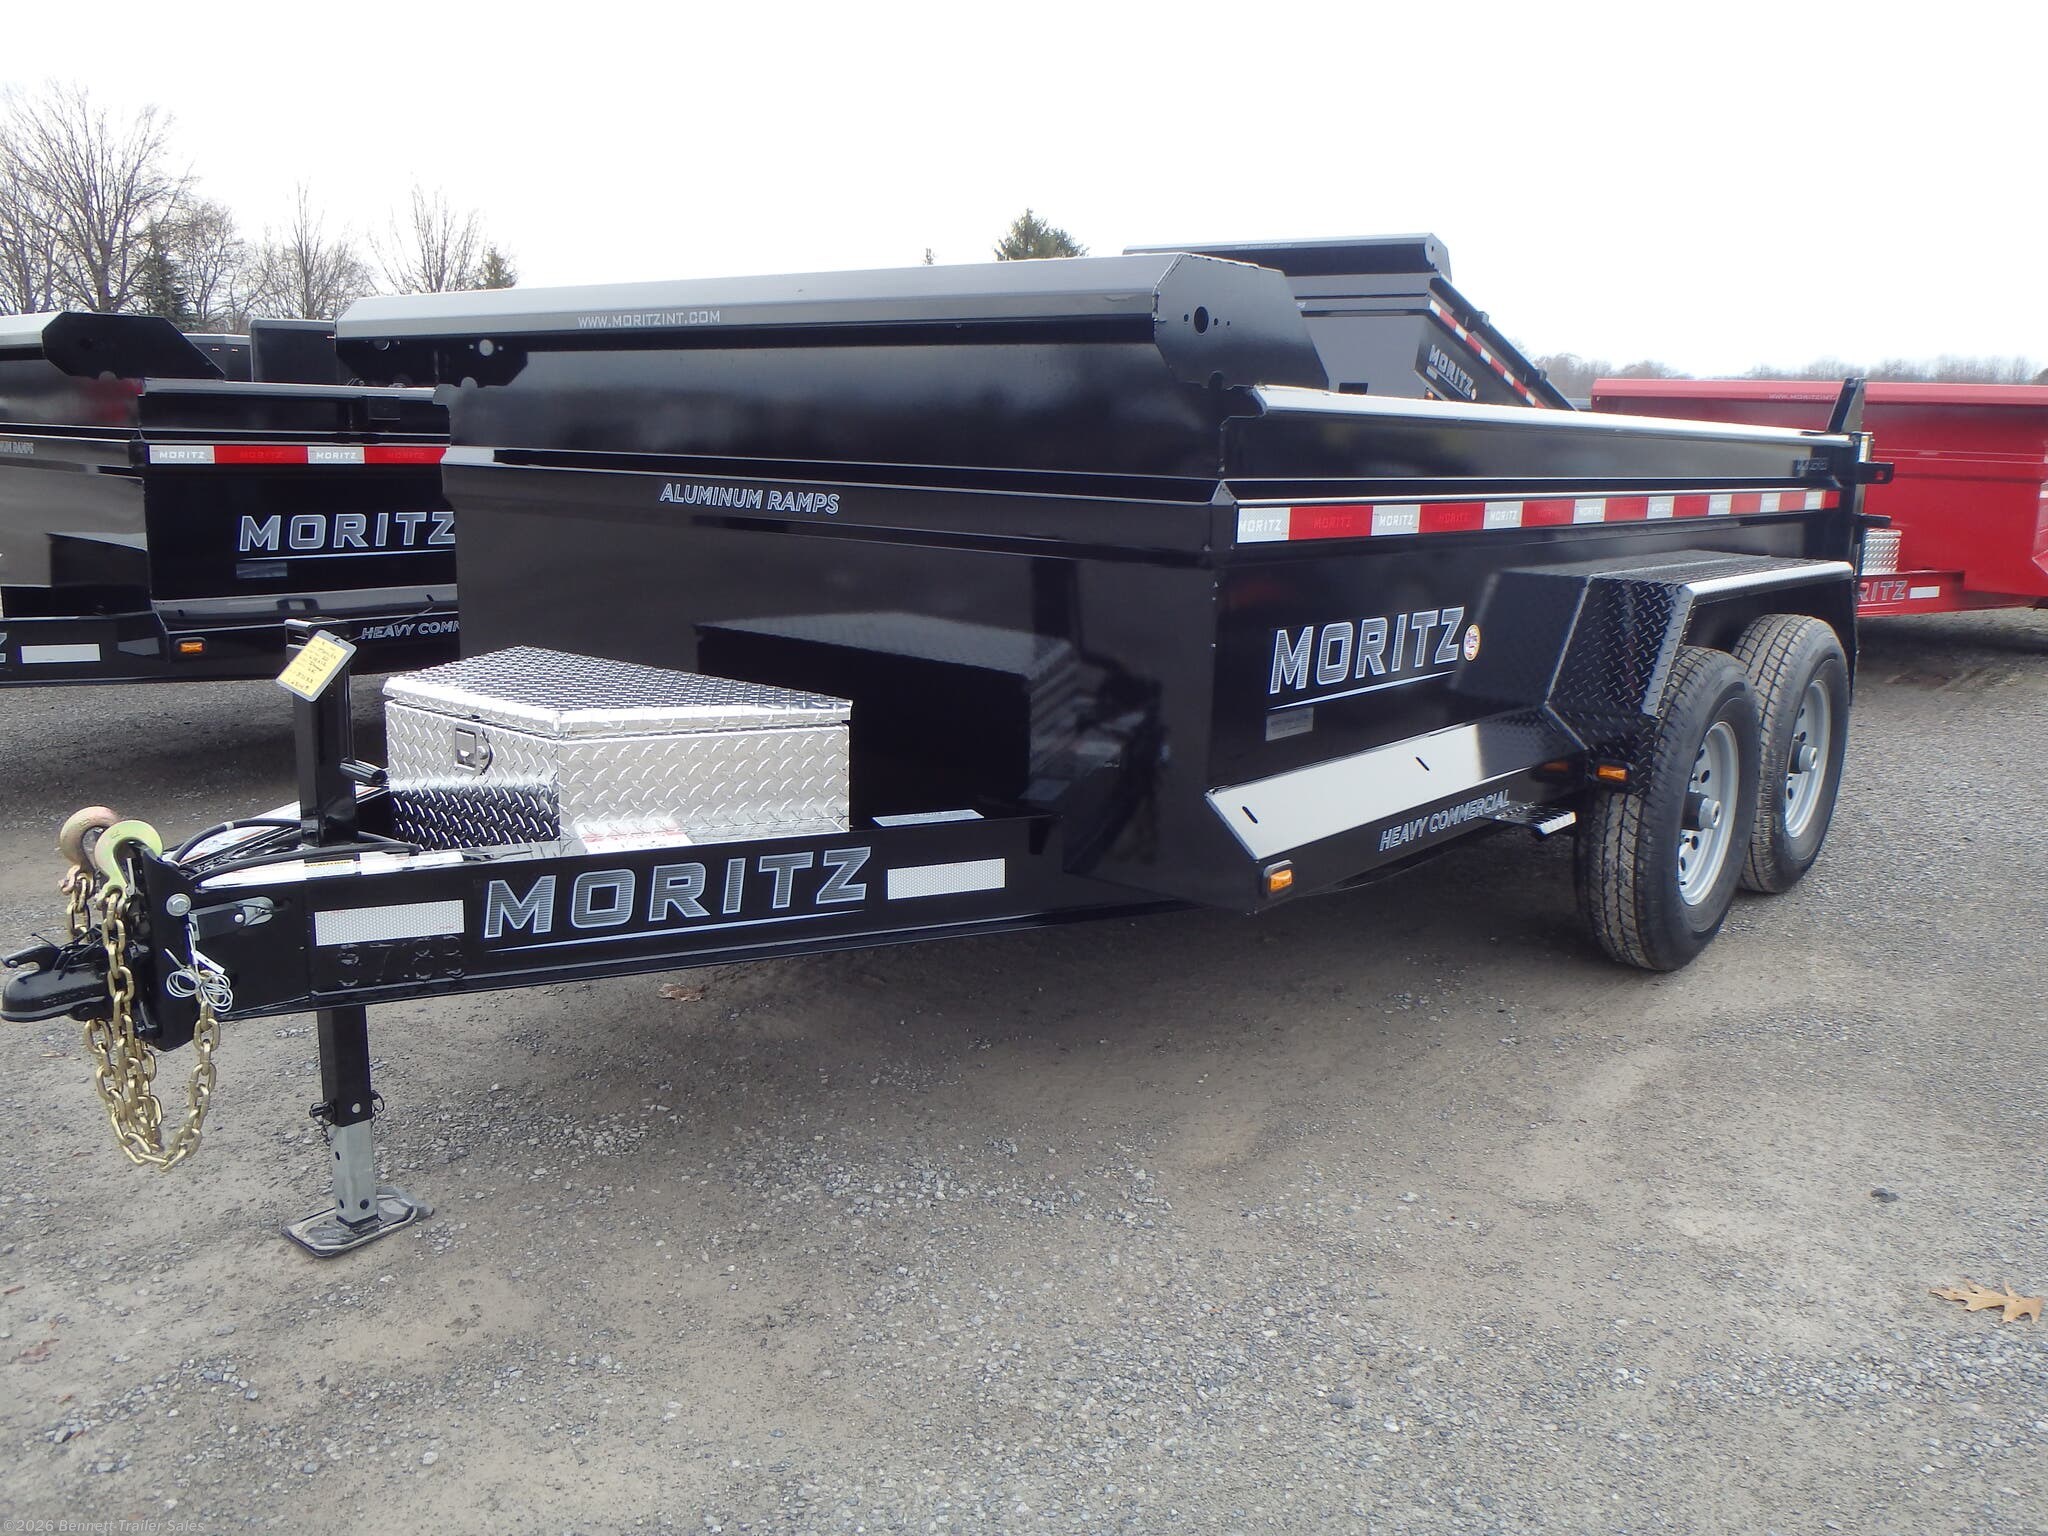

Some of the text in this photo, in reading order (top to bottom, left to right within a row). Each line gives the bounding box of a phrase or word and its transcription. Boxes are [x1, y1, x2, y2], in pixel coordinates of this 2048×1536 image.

[578, 310, 721, 329] WWW.MORITZINT.COM
[1428, 344, 1474, 396] MORITZ
[159, 451, 206, 460] MORITZ
[316, 452, 356, 460] MORITZ
[660, 483, 840, 515] ALUMINUM RAMPS
[239, 511, 456, 552] MORITZ
[1239, 519, 1281, 533] MORITZ
[1379, 514, 1414, 526] MORITZ
[1490, 509, 1521, 521] MORITZ
[1858, 581, 1907, 601] RITZ
[361, 624, 415, 640] HEAVY
[1270, 606, 1465, 695] MORITZ
[1379, 790, 1509, 851] HEAVY COMMERCIAL
[485, 846, 872, 938] MORITZ
